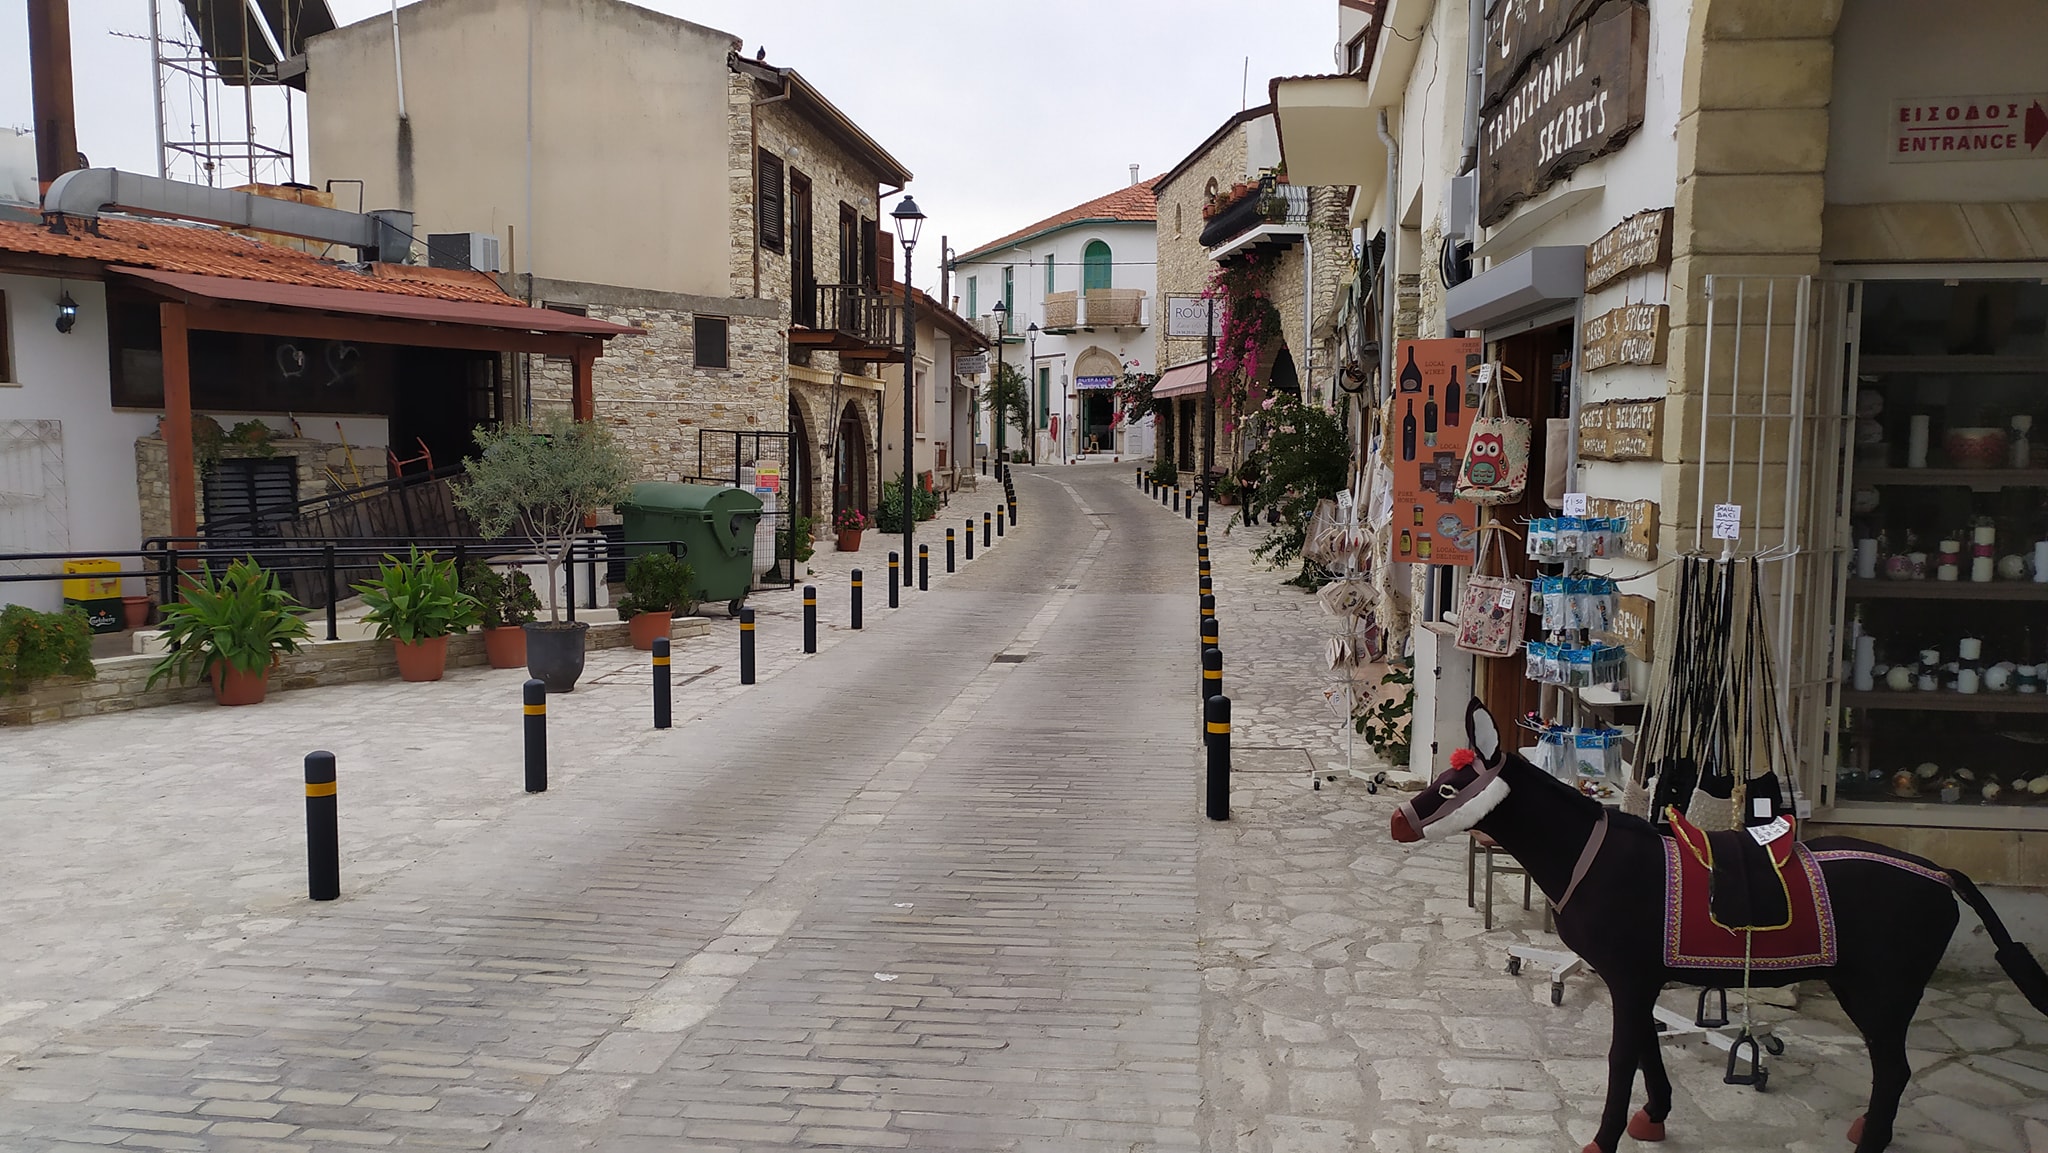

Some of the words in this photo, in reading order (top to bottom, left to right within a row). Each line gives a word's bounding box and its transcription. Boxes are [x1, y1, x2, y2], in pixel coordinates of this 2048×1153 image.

[1488, 34, 1584, 156] TRADITIONAL
[1900, 104, 2018, 122] ΕΙΣΟΔΟΣ
[1538, 90, 1608, 167] SECRETS
[1899, 134, 2017, 152] ENTRANCE
[1175, 307, 1220, 319] ROUVS
[1587, 317, 1607, 344] HERBS
[1625, 307, 1655, 331] SPICES
[1580, 409, 1603, 429] SWEETS
[1615, 405, 1654, 430] DELIGHTS
